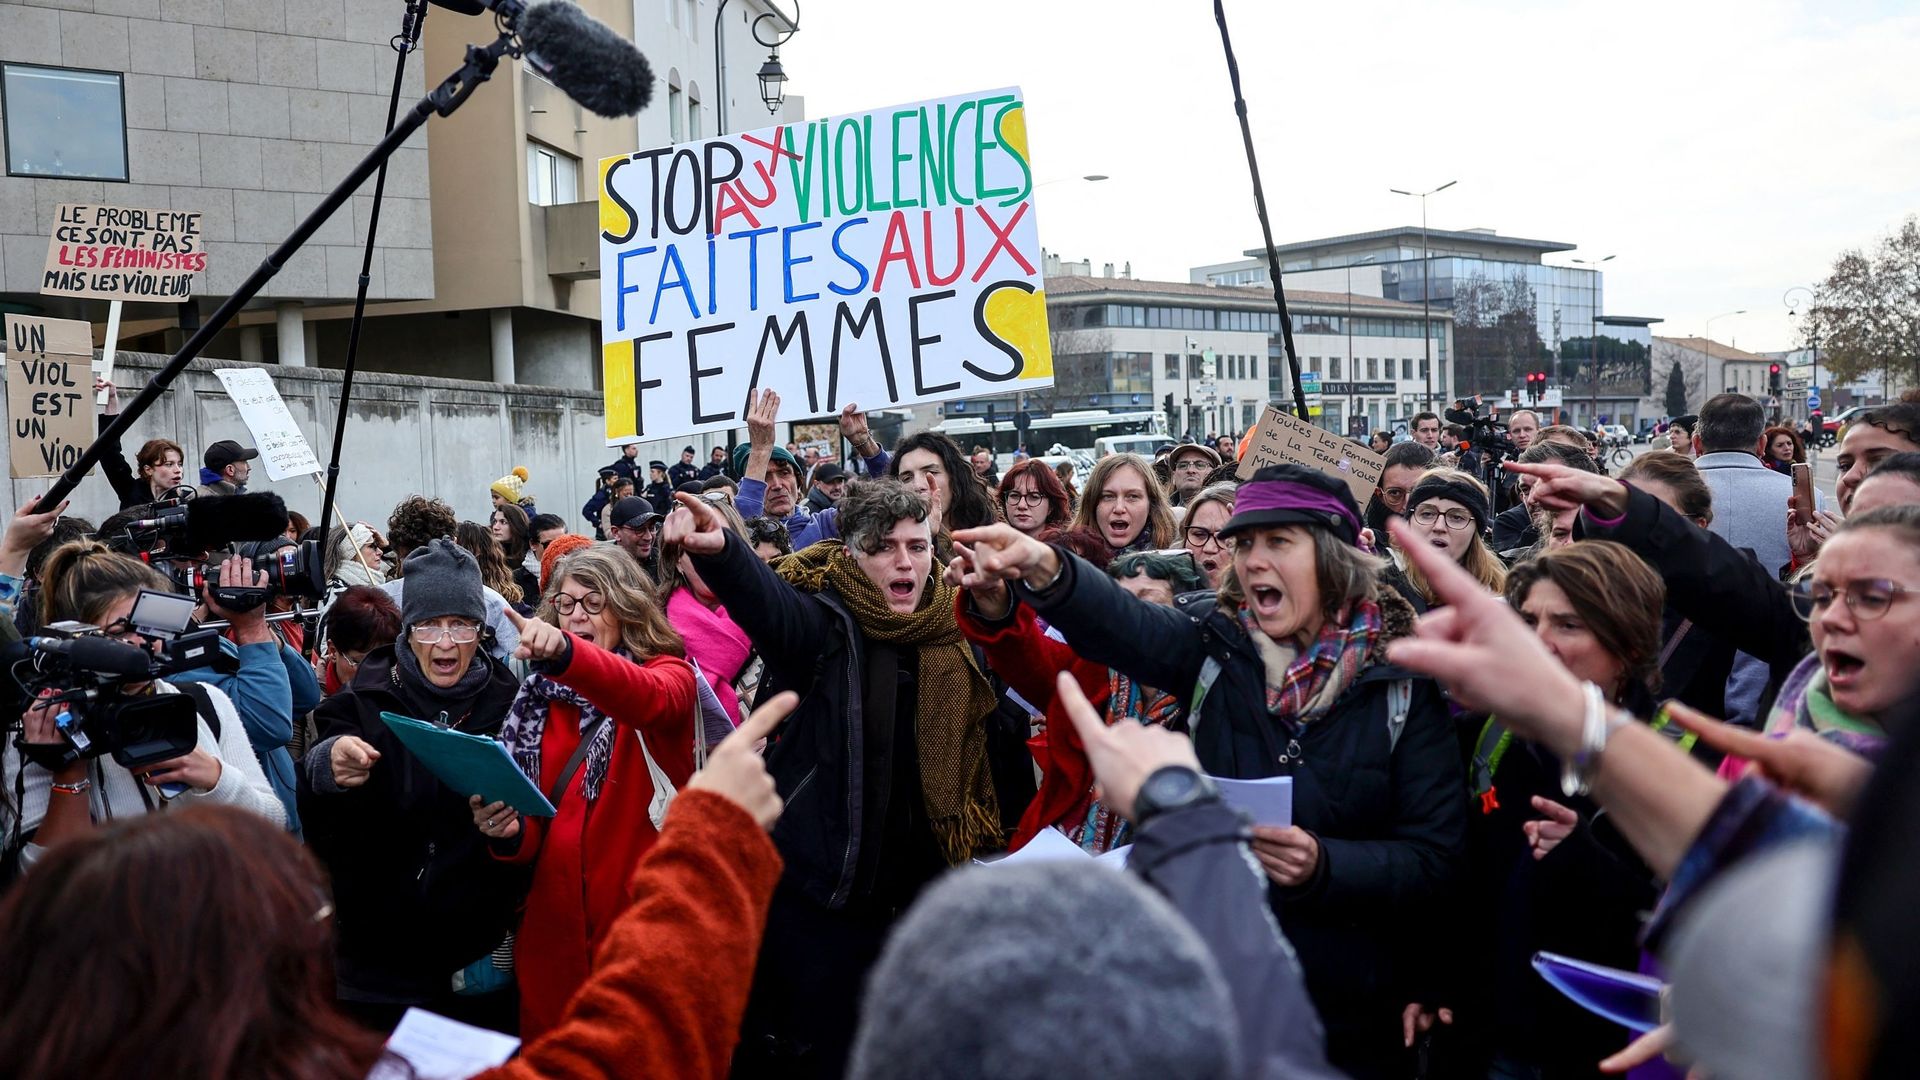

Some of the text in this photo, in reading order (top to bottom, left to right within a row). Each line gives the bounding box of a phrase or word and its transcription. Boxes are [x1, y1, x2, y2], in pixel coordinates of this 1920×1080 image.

[601, 141, 743, 244] STOP
[714, 126, 803, 235] AUX
[60, 205, 202, 235] LE PROBLEME
[59, 245, 98, 268] LES
[153, 233, 193, 254] PAS
[872, 202, 1037, 293] AUX
[91, 274, 121, 292] LES
[14, 323, 45, 354] UN
[632, 280, 1037, 437] FEMMES
[32, 392, 82, 417] EST
[16, 418, 46, 439] UN
[1268, 409, 1383, 471] Toutes Les Femmes
[1265, 429, 1278, 441] de
[1351, 467, 1376, 483] vous
[219, 592, 236, 600] Canon
